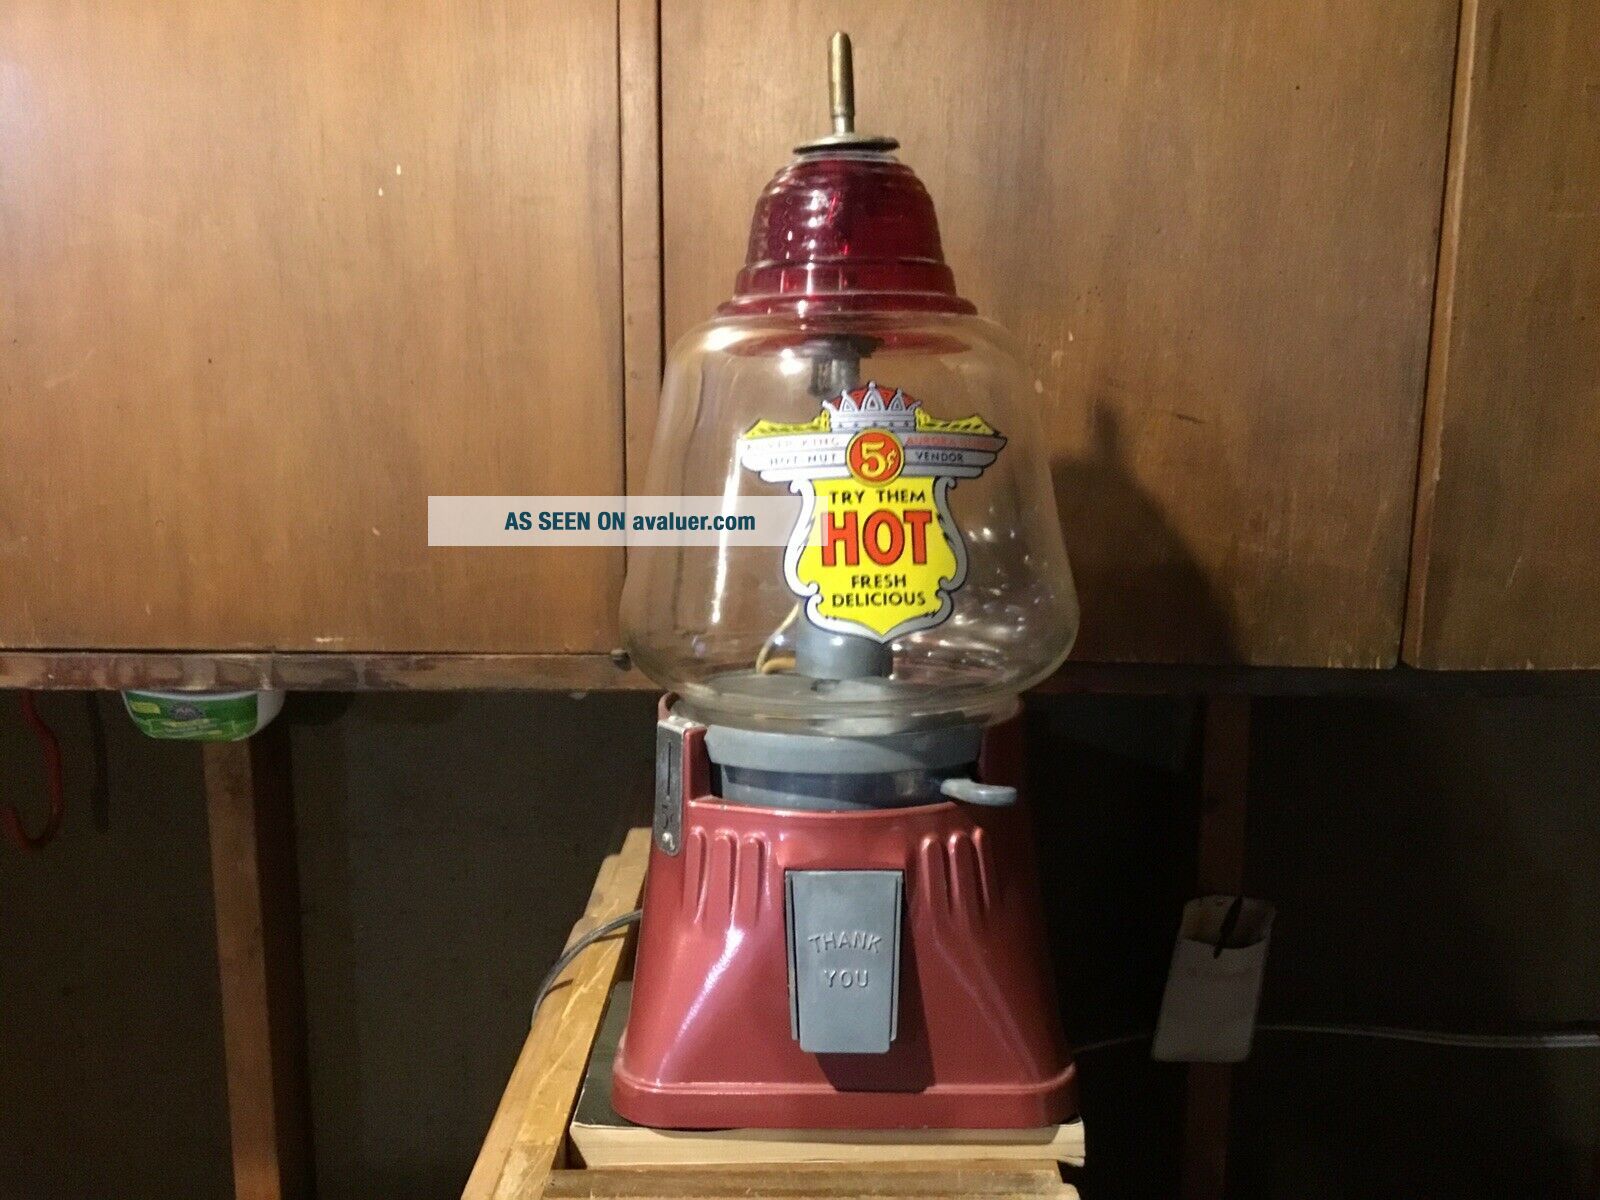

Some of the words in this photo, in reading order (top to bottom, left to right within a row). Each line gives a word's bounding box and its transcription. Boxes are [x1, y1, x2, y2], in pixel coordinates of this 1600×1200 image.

[915, 451, 964, 462] VENDOR
[829, 489, 866, 504] TRY
[876, 488, 926, 503] THEM
[821, 509, 932, 566] HOT
[851, 573, 907, 589] FRESH
[832, 591, 926, 608] DELICIOUS
[807, 931, 882, 953] THANK
[824, 969, 868, 988] YOU
